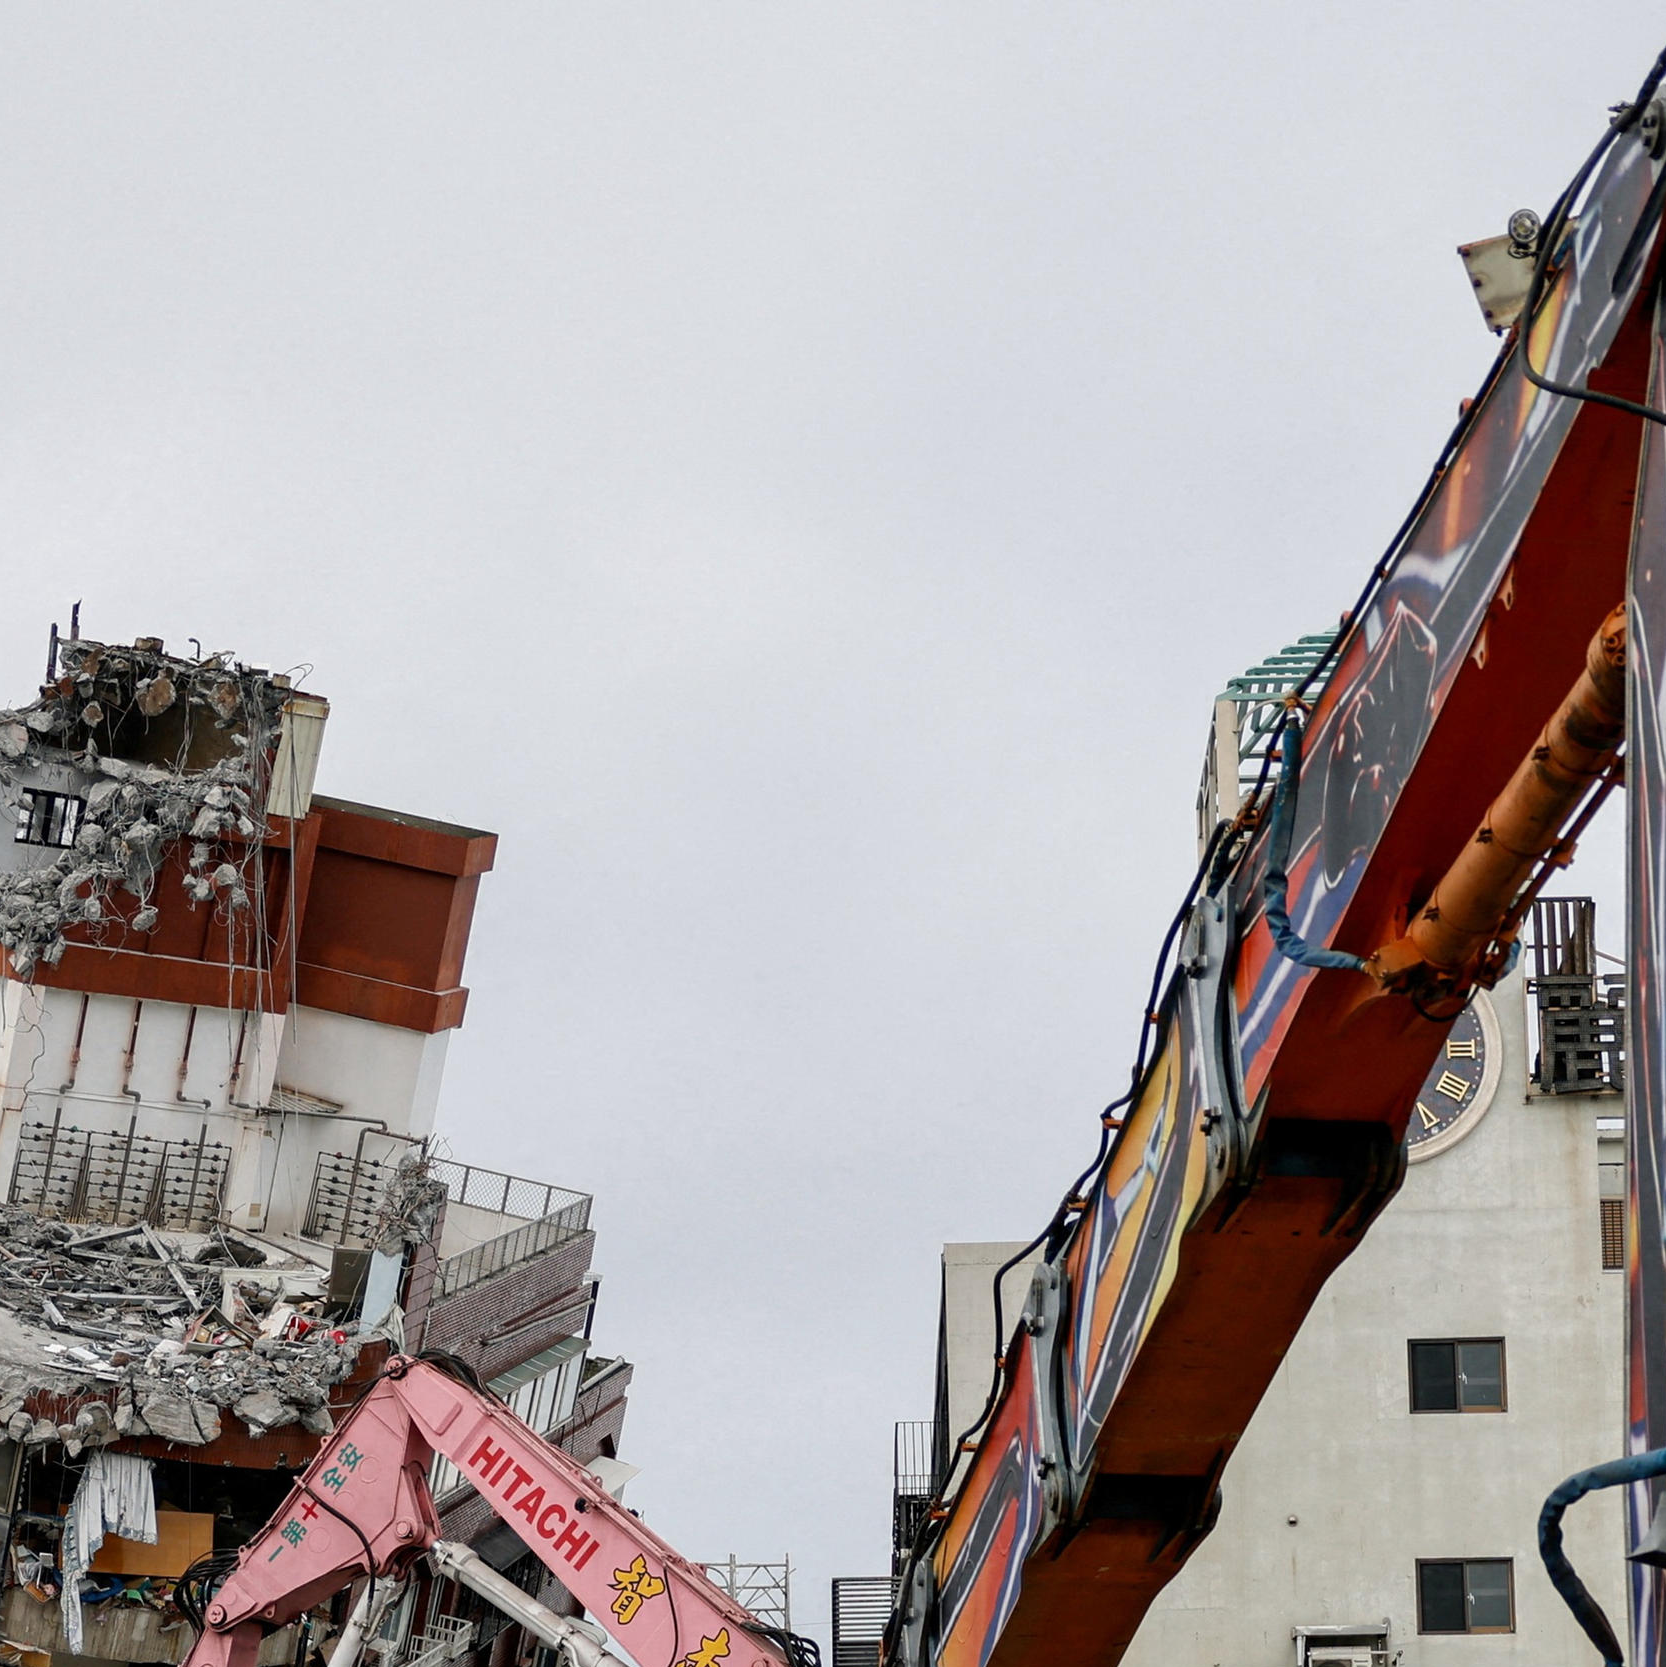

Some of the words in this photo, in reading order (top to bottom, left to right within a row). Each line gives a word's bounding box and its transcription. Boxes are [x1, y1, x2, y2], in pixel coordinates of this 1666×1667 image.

[321, 1442, 364, 1494] 安全
[467, 1436, 601, 1572] HITACHI
[267, 1517, 308, 1562] 第一
